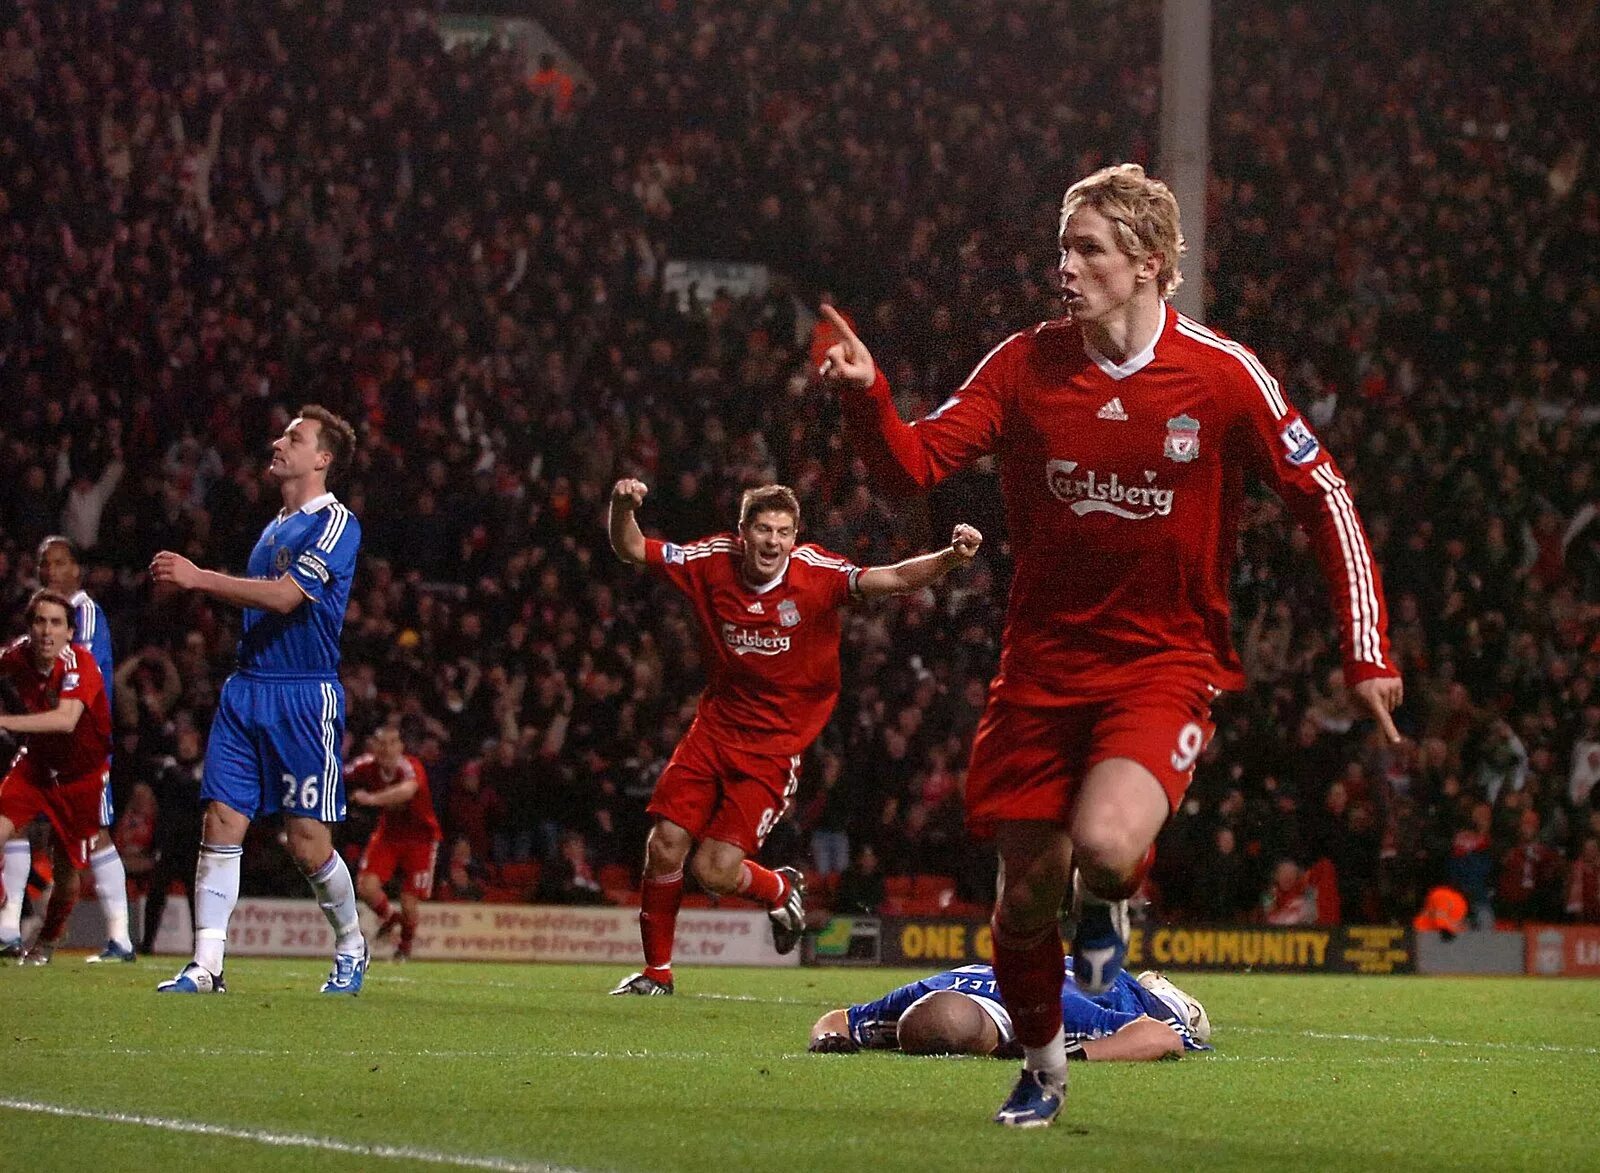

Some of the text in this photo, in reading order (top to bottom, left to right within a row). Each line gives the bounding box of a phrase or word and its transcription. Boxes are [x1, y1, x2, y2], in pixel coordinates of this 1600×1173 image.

[1046, 458, 1174, 520] Carlsberg
[722, 622, 791, 656] Carlsberg
[1171, 721, 1203, 771] 9
[282, 773, 319, 809] 26
[756, 807, 774, 838] 8
[493, 912, 620, 936] Weddings
[902, 923, 967, 959] ONE
[1152, 927, 1331, 966] COMMUNITY
